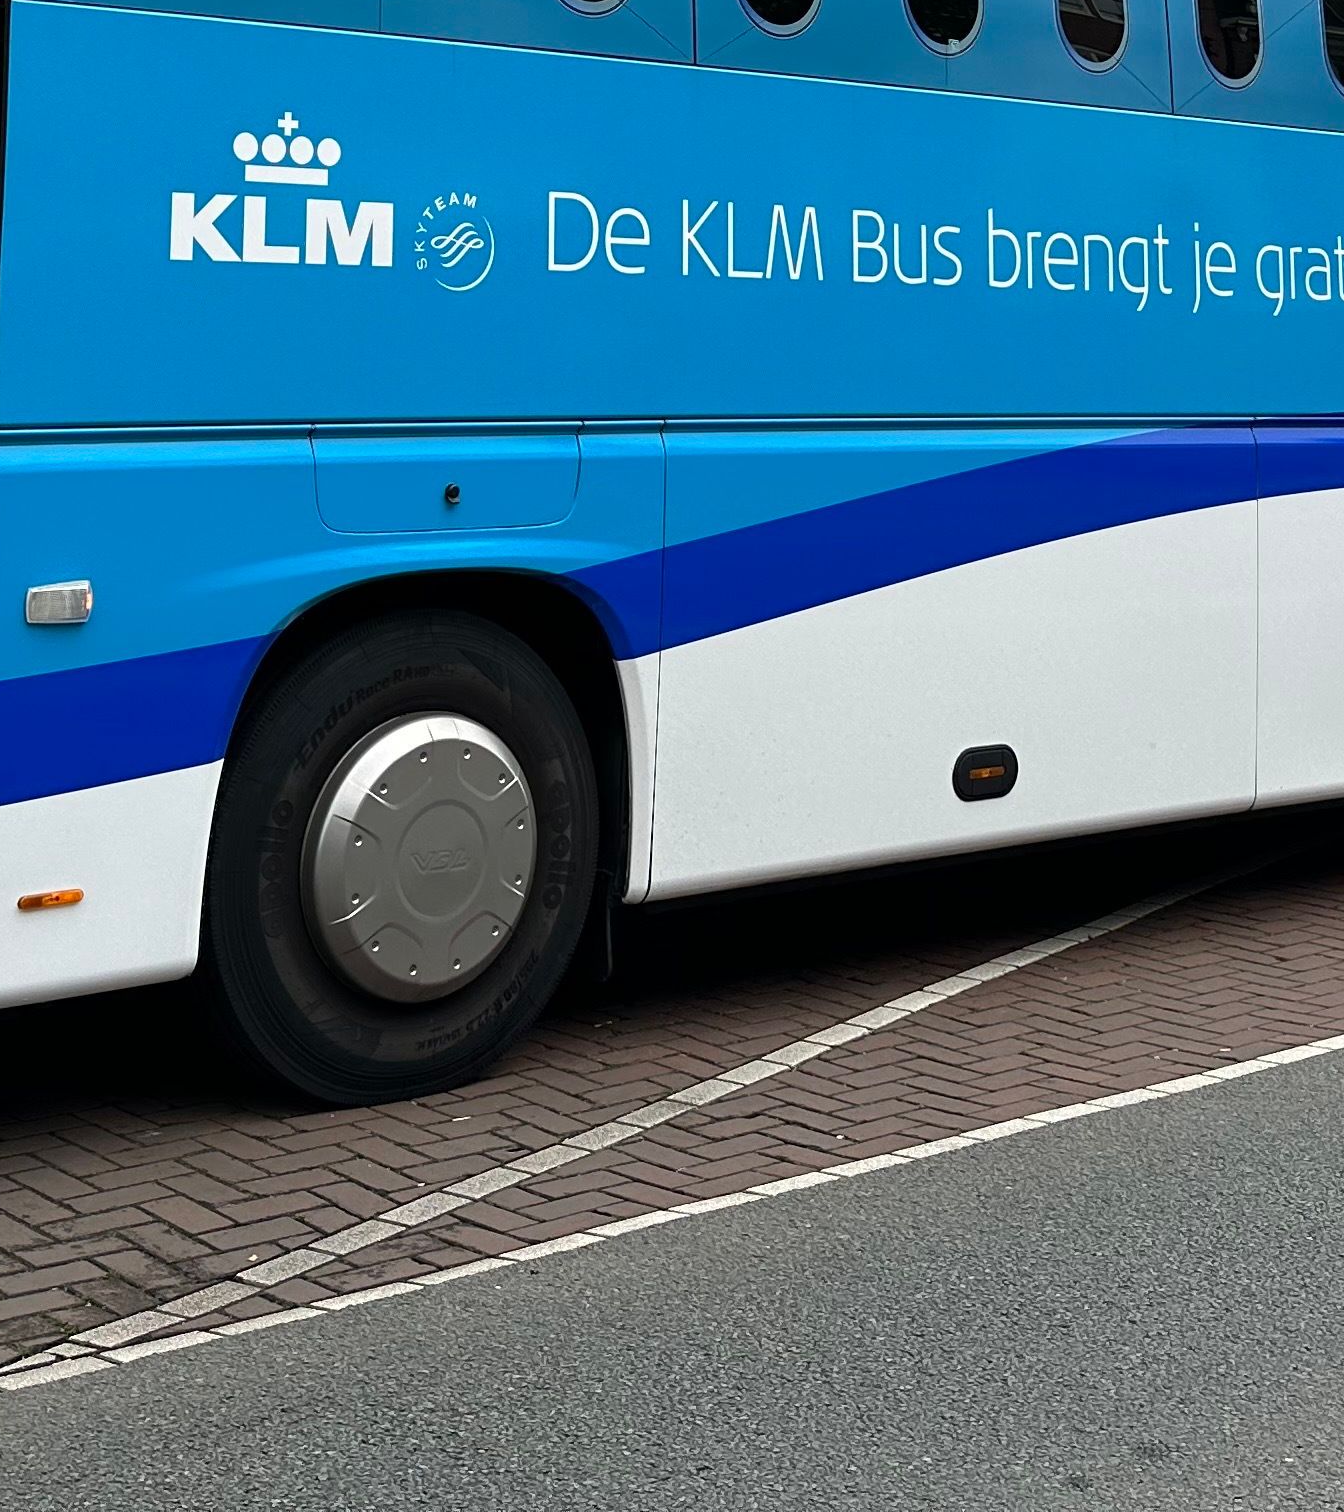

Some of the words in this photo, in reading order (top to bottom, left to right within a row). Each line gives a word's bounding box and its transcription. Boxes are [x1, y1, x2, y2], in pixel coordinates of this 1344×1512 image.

[169, 191, 394, 267] KLM
[548, 191, 651, 274] De
[682, 199, 824, 281] KLM
[853, 209, 963, 286] Bus
[987, 208, 1172, 312] brengt
[1192, 222, 1236, 314] je
